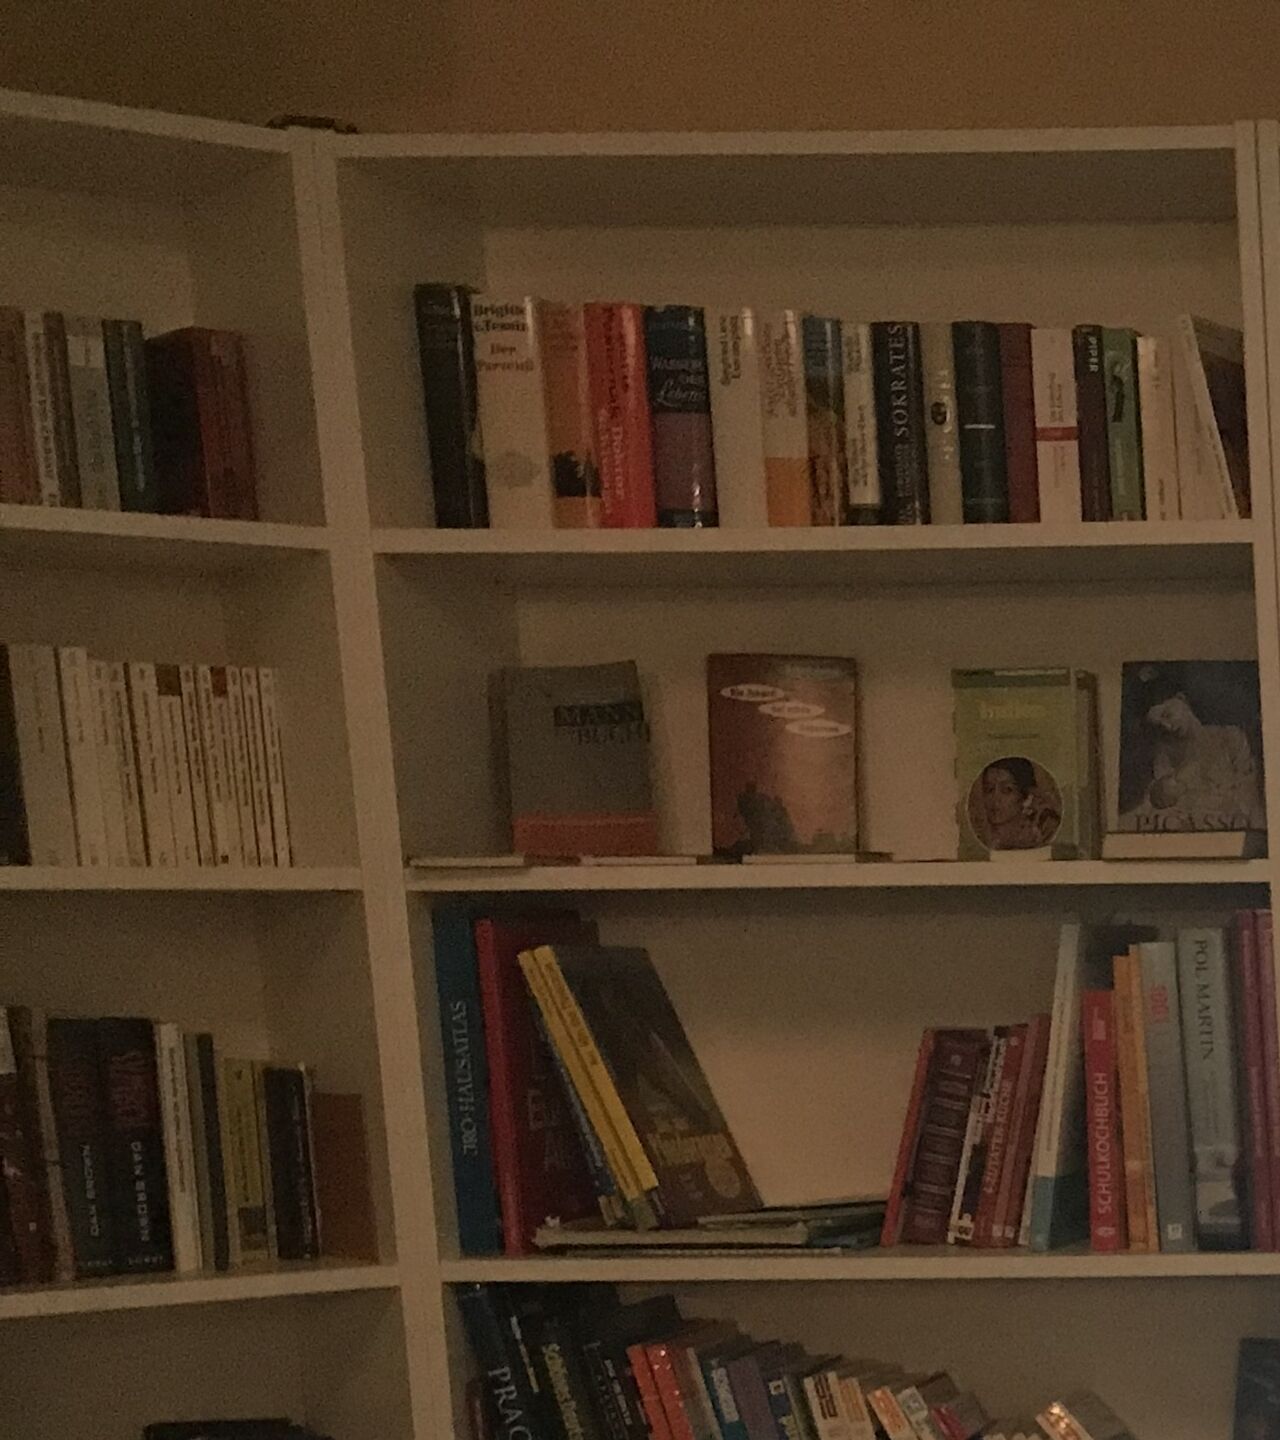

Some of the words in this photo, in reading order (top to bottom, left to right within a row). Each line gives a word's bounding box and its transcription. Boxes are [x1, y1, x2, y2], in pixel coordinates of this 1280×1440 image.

[886, 323, 910, 438] SOKRATES
[1086, 333, 1100, 374] PIPER
[1199, 983, 1215, 1061] MARTIN
[1092, 1071, 1116, 1216] SCHULKOCHBUCH
